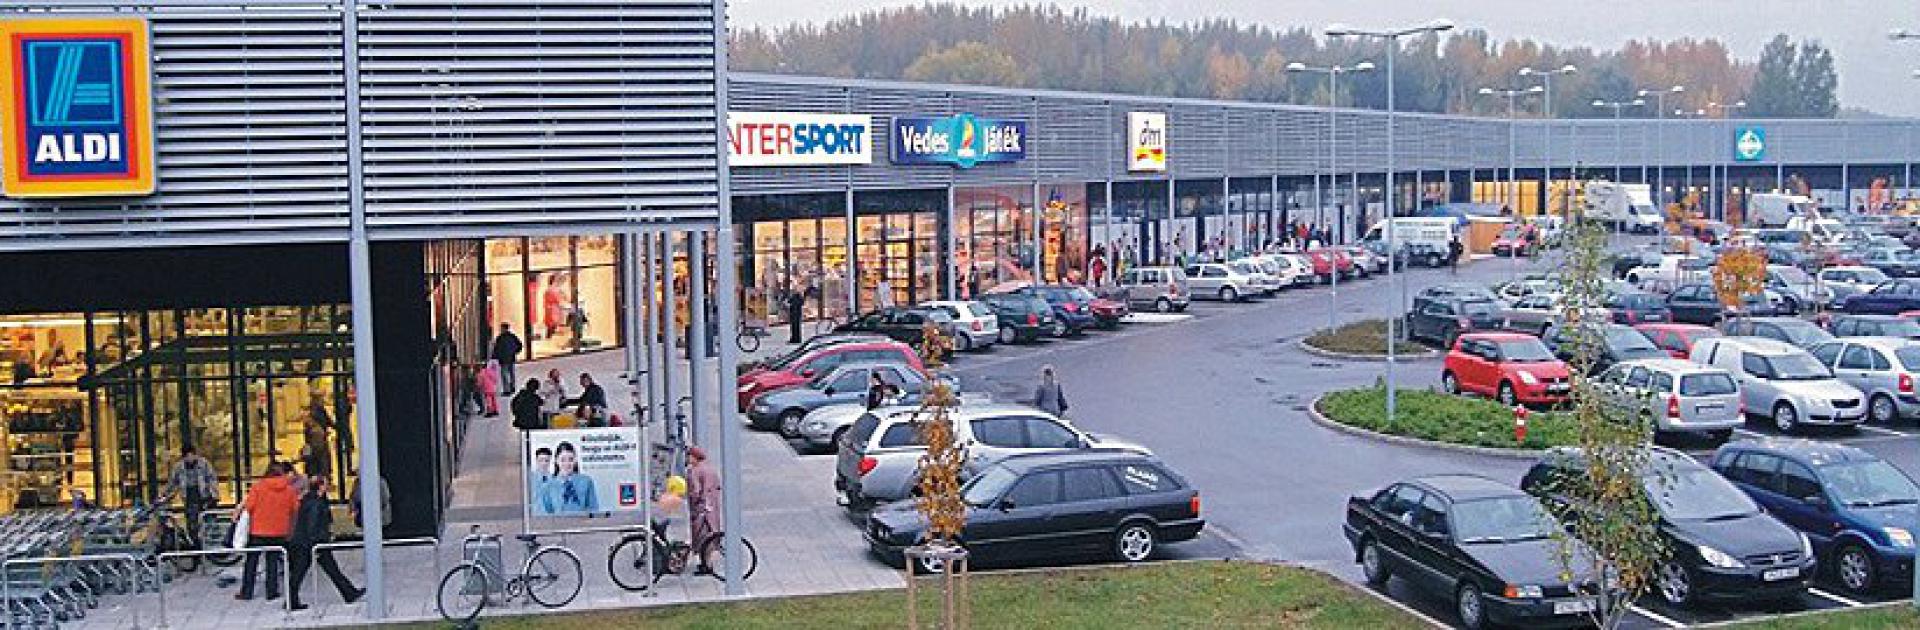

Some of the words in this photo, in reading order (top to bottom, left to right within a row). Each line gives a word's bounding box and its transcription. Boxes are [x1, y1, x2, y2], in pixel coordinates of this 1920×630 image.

[35, 133, 120, 162] ALDI
[728, 123, 865, 154] NTERSPORT
[901, 125, 949, 154] Vedes
[983, 125, 1021, 156] Játék
[1139, 119, 1161, 146] dm
